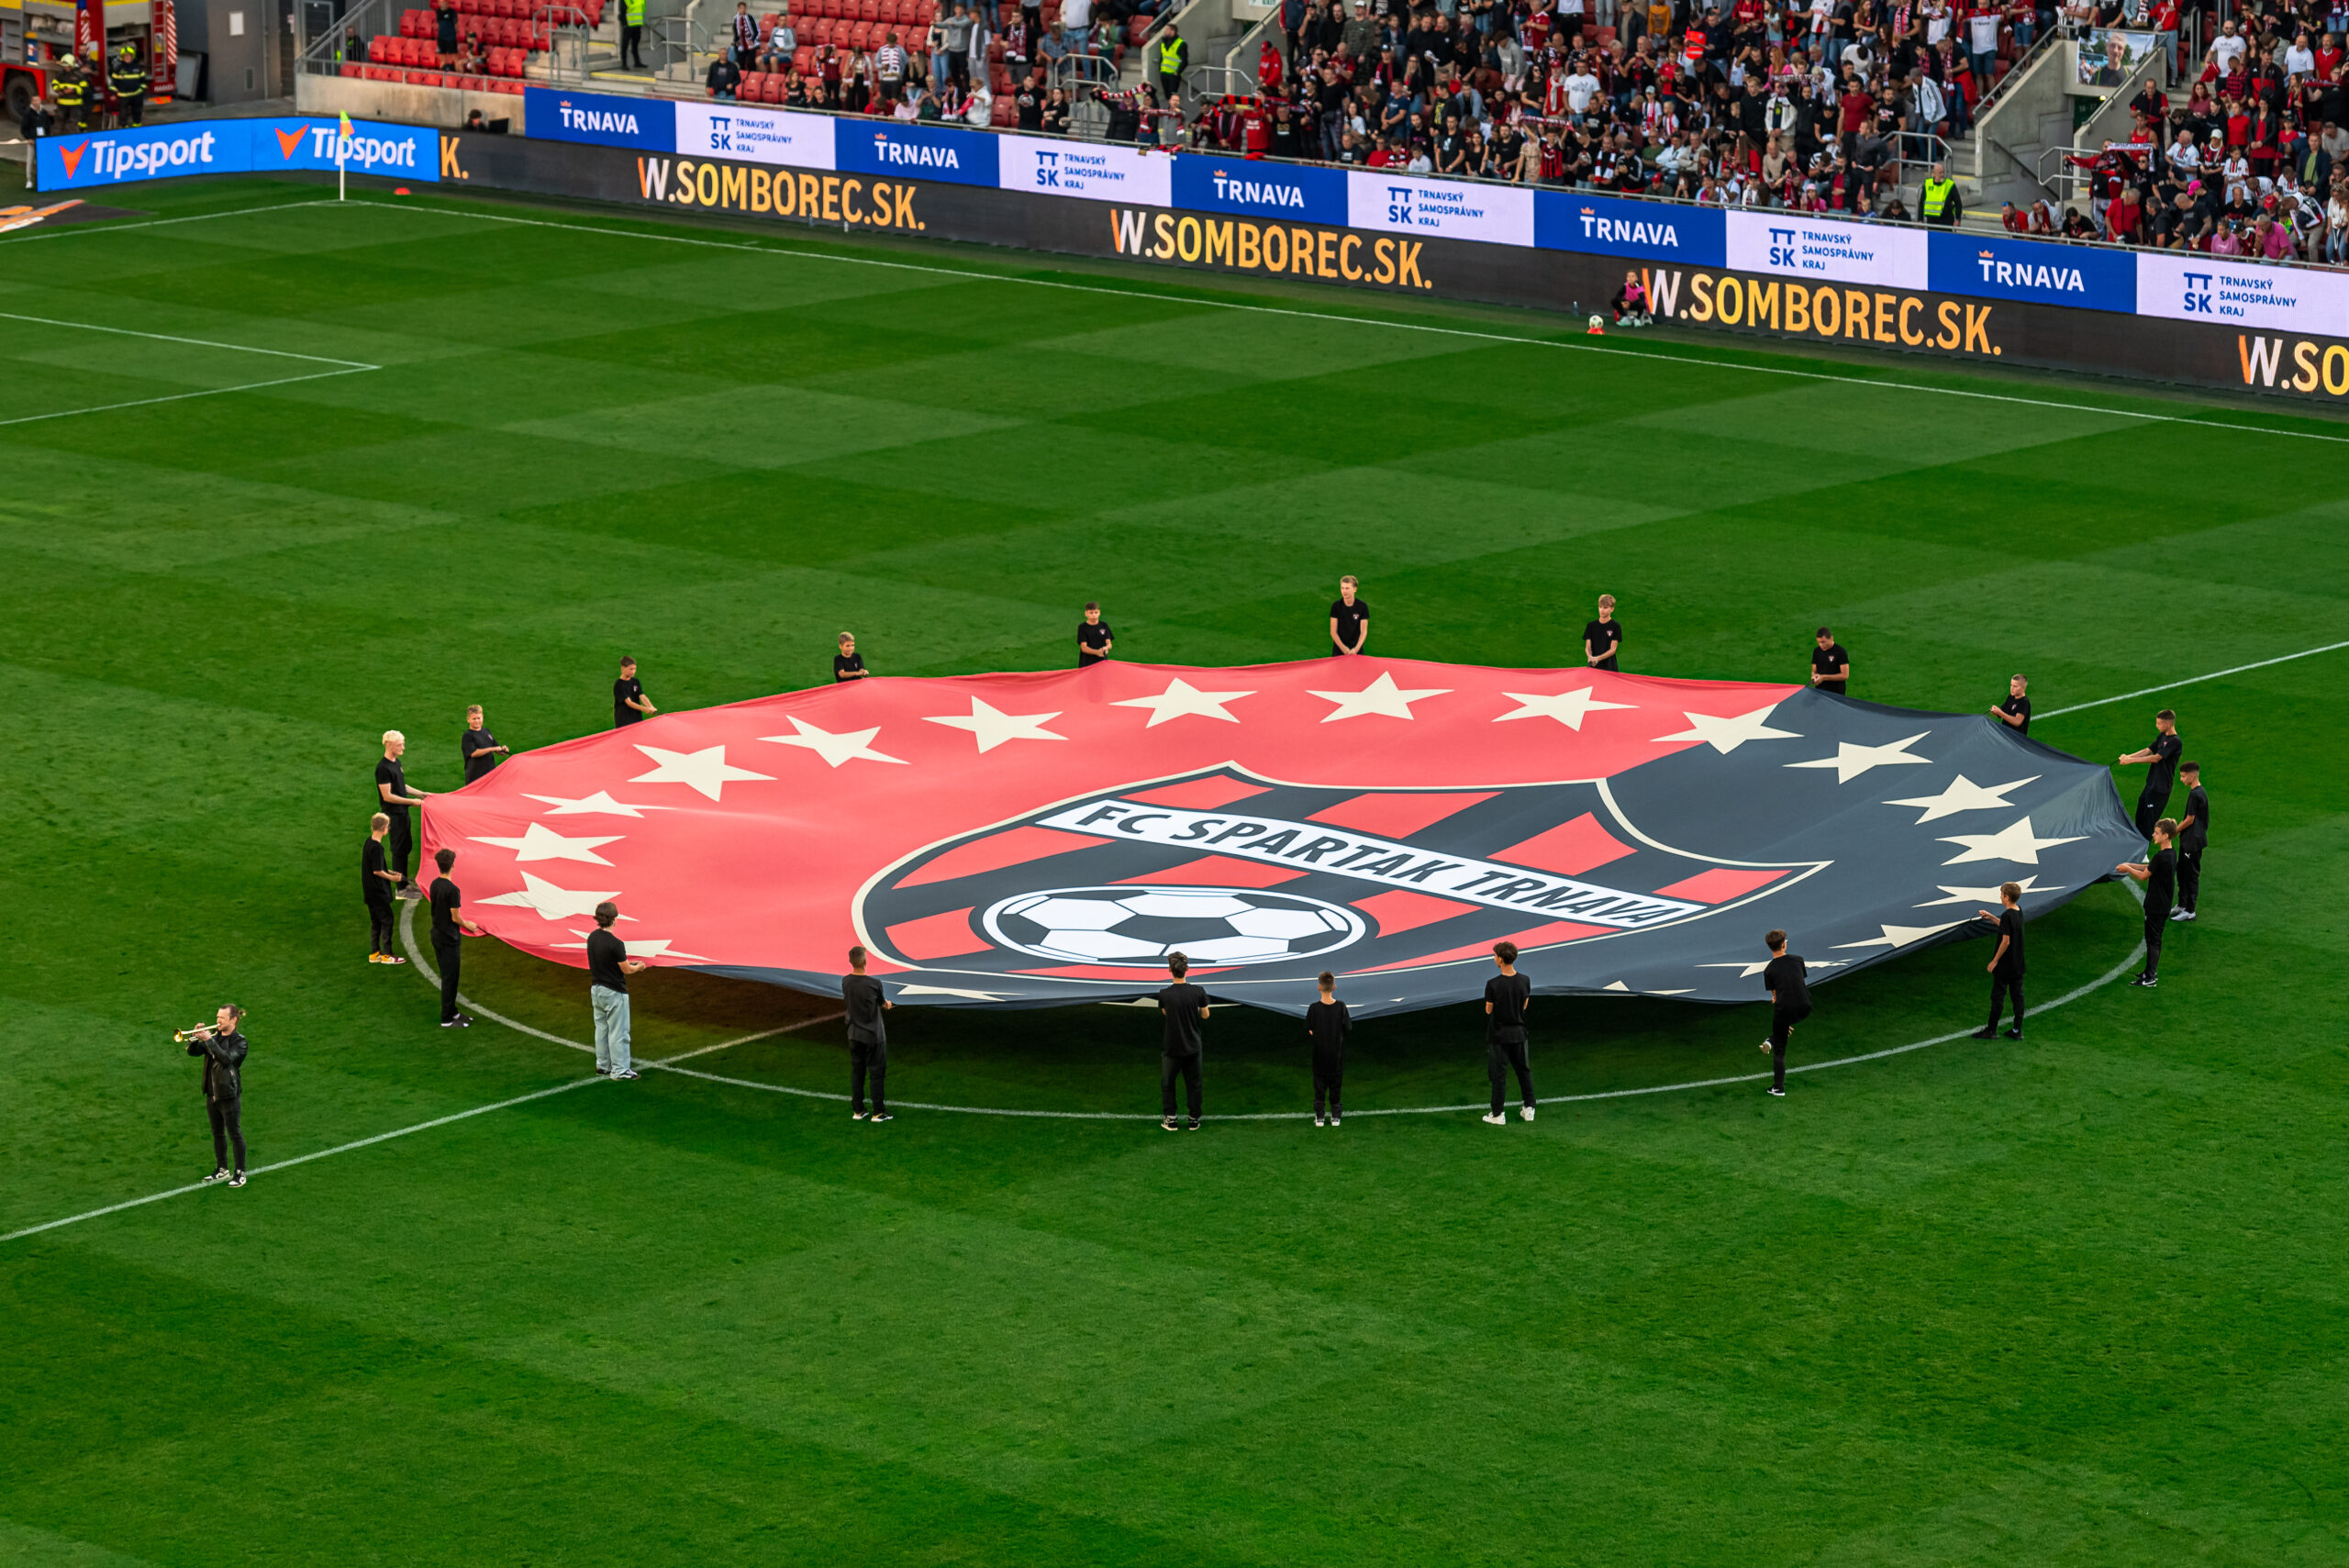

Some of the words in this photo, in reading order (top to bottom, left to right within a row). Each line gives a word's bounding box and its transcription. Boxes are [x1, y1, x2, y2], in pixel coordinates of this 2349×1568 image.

[560, 107, 640, 135] TRNAVA
[709, 117, 731, 131] TT
[311, 128, 417, 169] Tipsport
[710, 133, 731, 150] SK
[92, 131, 216, 179] Tipsport
[874, 140, 960, 169] TRNAVA
[1035, 150, 1059, 166] TT
[1037, 168, 1060, 187] SK
[1213, 177, 1305, 208] TRNAVA
[1387, 186, 1413, 203] TT
[1418, 189, 1464, 202] TRNAVSKÝ
[1388, 205, 1413, 224] SK
[1418, 217, 1440, 228] KRAJ
[1579, 215, 1679, 247] TRNAVA
[1768, 228, 1796, 245] TT
[1802, 231, 1852, 244] TRNAVSKÝ
[1769, 247, 1796, 267] SK
[1802, 245, 1874, 261] SAMOSPRÁVNY
[1802, 260, 1825, 271] KRAJ
[1977, 259, 2086, 292] TRNAVA
[2183, 272, 2213, 290] TT
[2220, 276, 2274, 290] TRNAVSKÝ
[2184, 292, 2213, 313] SK
[2220, 291, 2297, 307] SAMOSPRÁVNY
[2220, 306, 2244, 317] KRAJ
[1074, 805, 1173, 834] FC
[1168, 819, 1467, 884] SPARTAK
[1450, 870, 1687, 923] TRNAVA
